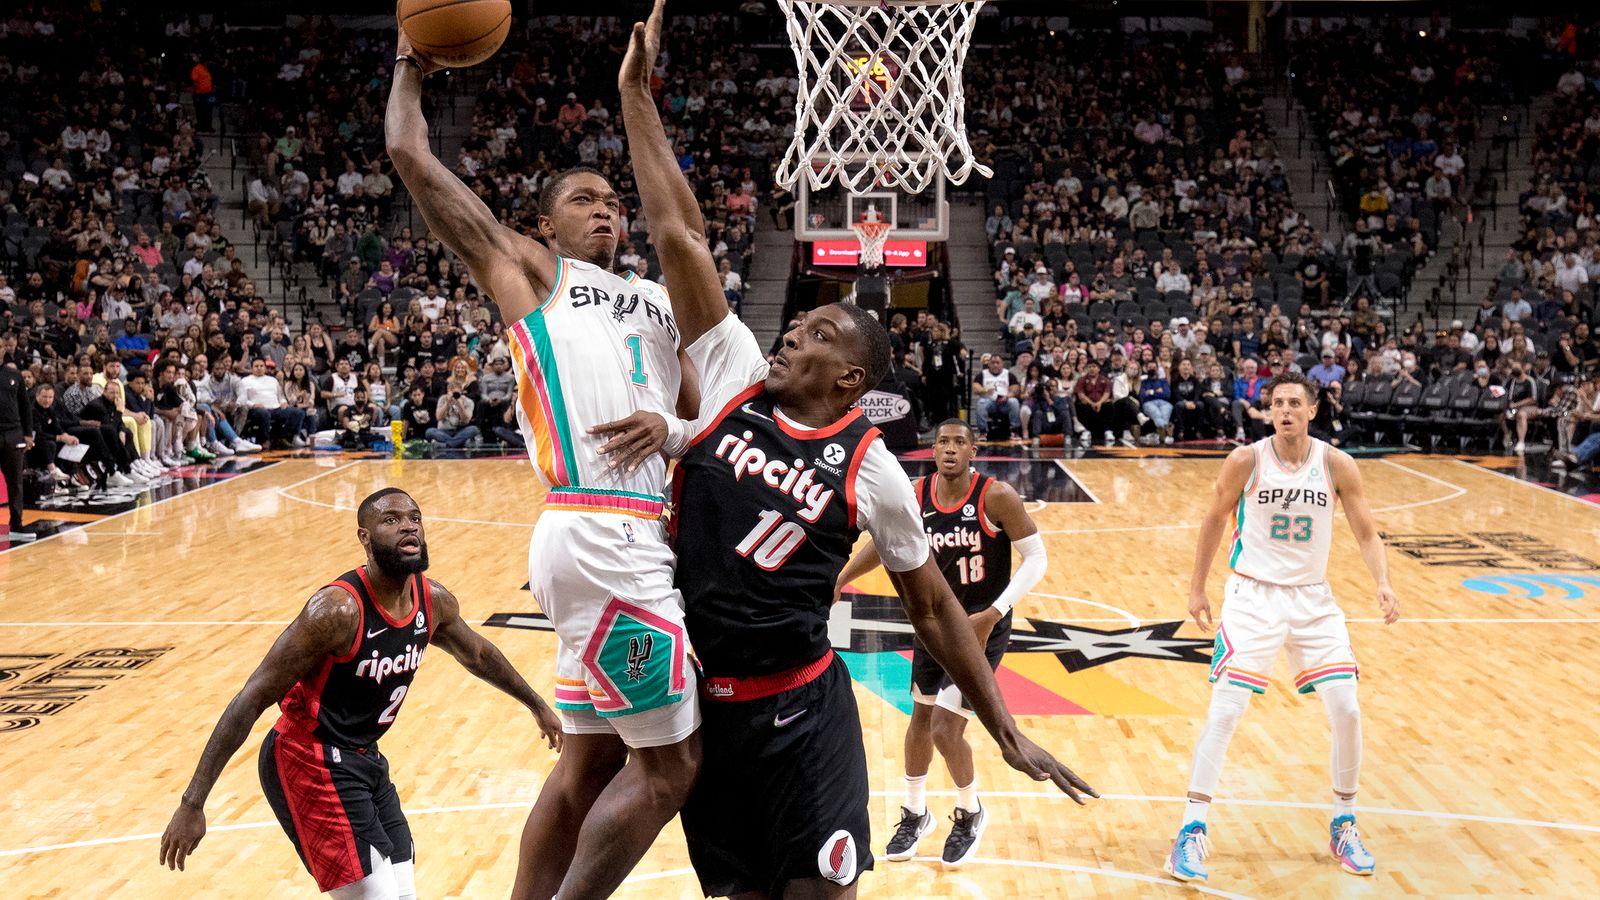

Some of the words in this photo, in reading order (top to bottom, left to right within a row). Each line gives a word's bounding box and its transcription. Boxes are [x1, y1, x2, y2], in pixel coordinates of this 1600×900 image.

[569, 285, 678, 343] SPURS
[624, 333, 649, 388] 1
[857, 397, 894, 407] RAKE
[862, 408, 893, 418] HECK
[714, 430, 835, 524] ripcity
[814, 457, 843, 477] StormX
[1258, 488, 1328, 511] SPURS
[735, 509, 807, 572] 10
[926, 526, 982, 555] ipcity
[1269, 513, 1313, 543] 23
[956, 554, 985, 585] 18
[377, 685, 408, 725] 2
